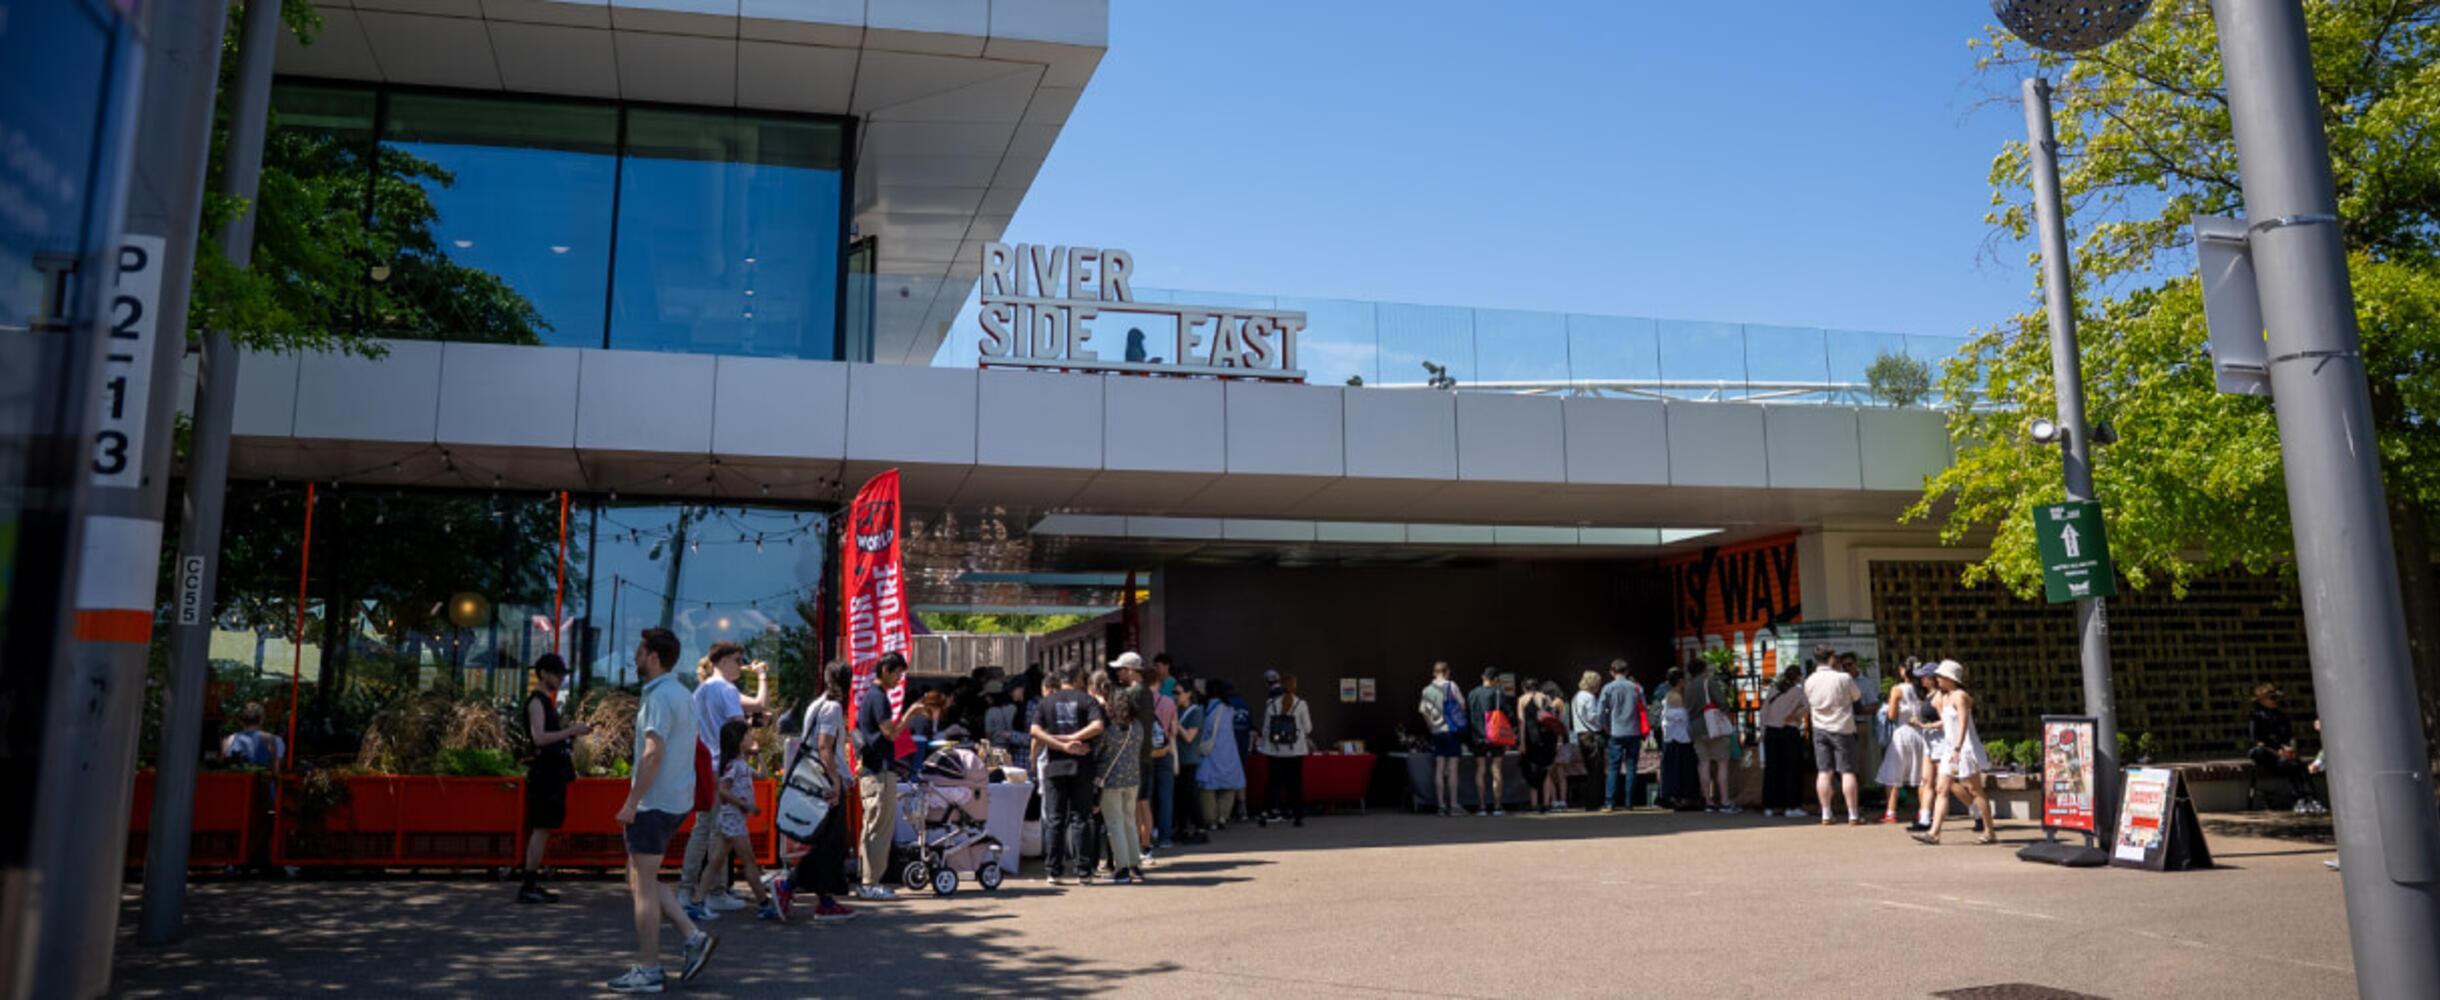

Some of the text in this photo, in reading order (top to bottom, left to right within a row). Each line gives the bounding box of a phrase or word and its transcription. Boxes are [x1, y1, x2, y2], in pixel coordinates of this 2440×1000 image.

[980, 241, 1134, 302] RIVER
[93, 245, 149, 475] P2-13
[978, 302, 1306, 371] SIDE EAST
[856, 529, 894, 551] WORLD
[184, 559, 202, 622] CC55
[1715, 544, 1797, 625] WAY
[850, 594, 879, 666] YOUR
